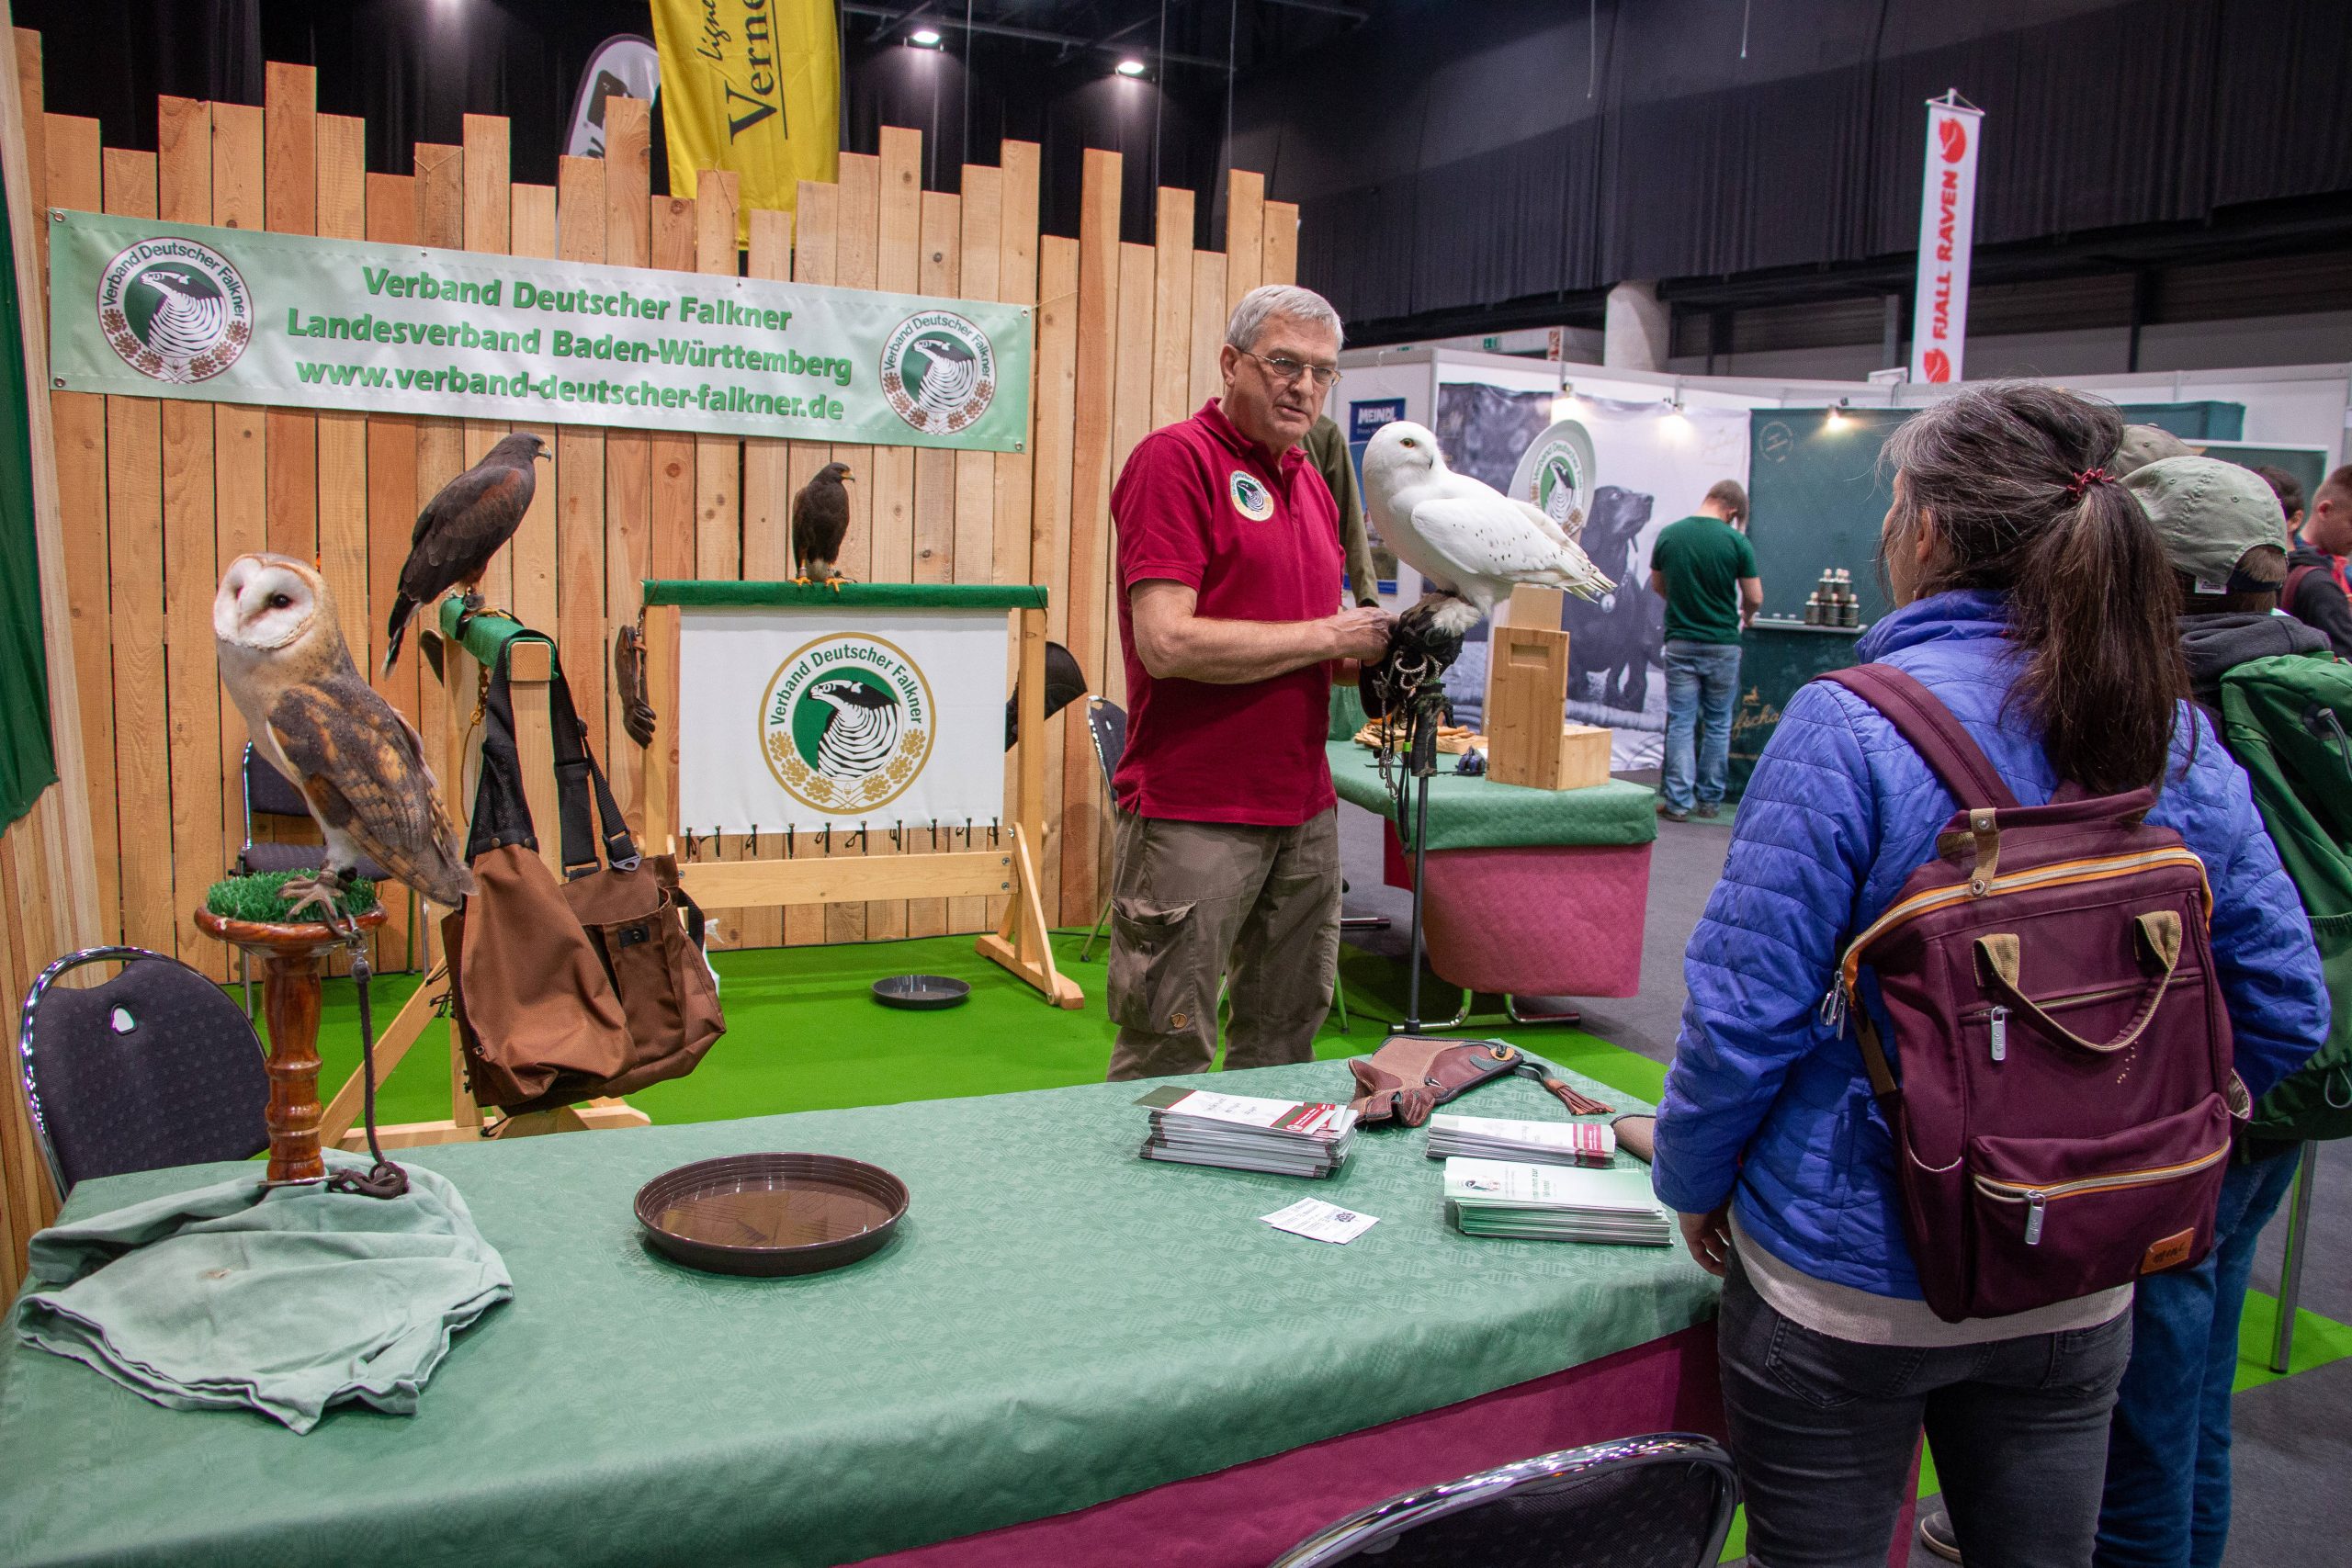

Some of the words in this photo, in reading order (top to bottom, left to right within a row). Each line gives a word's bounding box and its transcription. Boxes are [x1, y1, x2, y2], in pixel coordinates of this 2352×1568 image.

[102, 254, 141, 307] Verband
[138, 242, 220, 271] Deutscher
[217, 265, 246, 319] Falkner
[362, 265, 503, 307] Verband
[513, 280, 671, 321] Deutscher
[679, 296, 793, 331] Falkner
[287, 307, 541, 355] Landesverband
[552, 329, 853, 387] Baden-Württemberg
[884, 324, 914, 371] Verband
[911, 315, 973, 337] Deutscher
[971, 333, 990, 378] Falkner
[295, 361, 844, 421] www.verband-deutscher-falkner.de
[770, 660, 811, 726] Verband
[809, 644, 894, 670] Deutscher
[891, 663, 922, 725] Falkner
